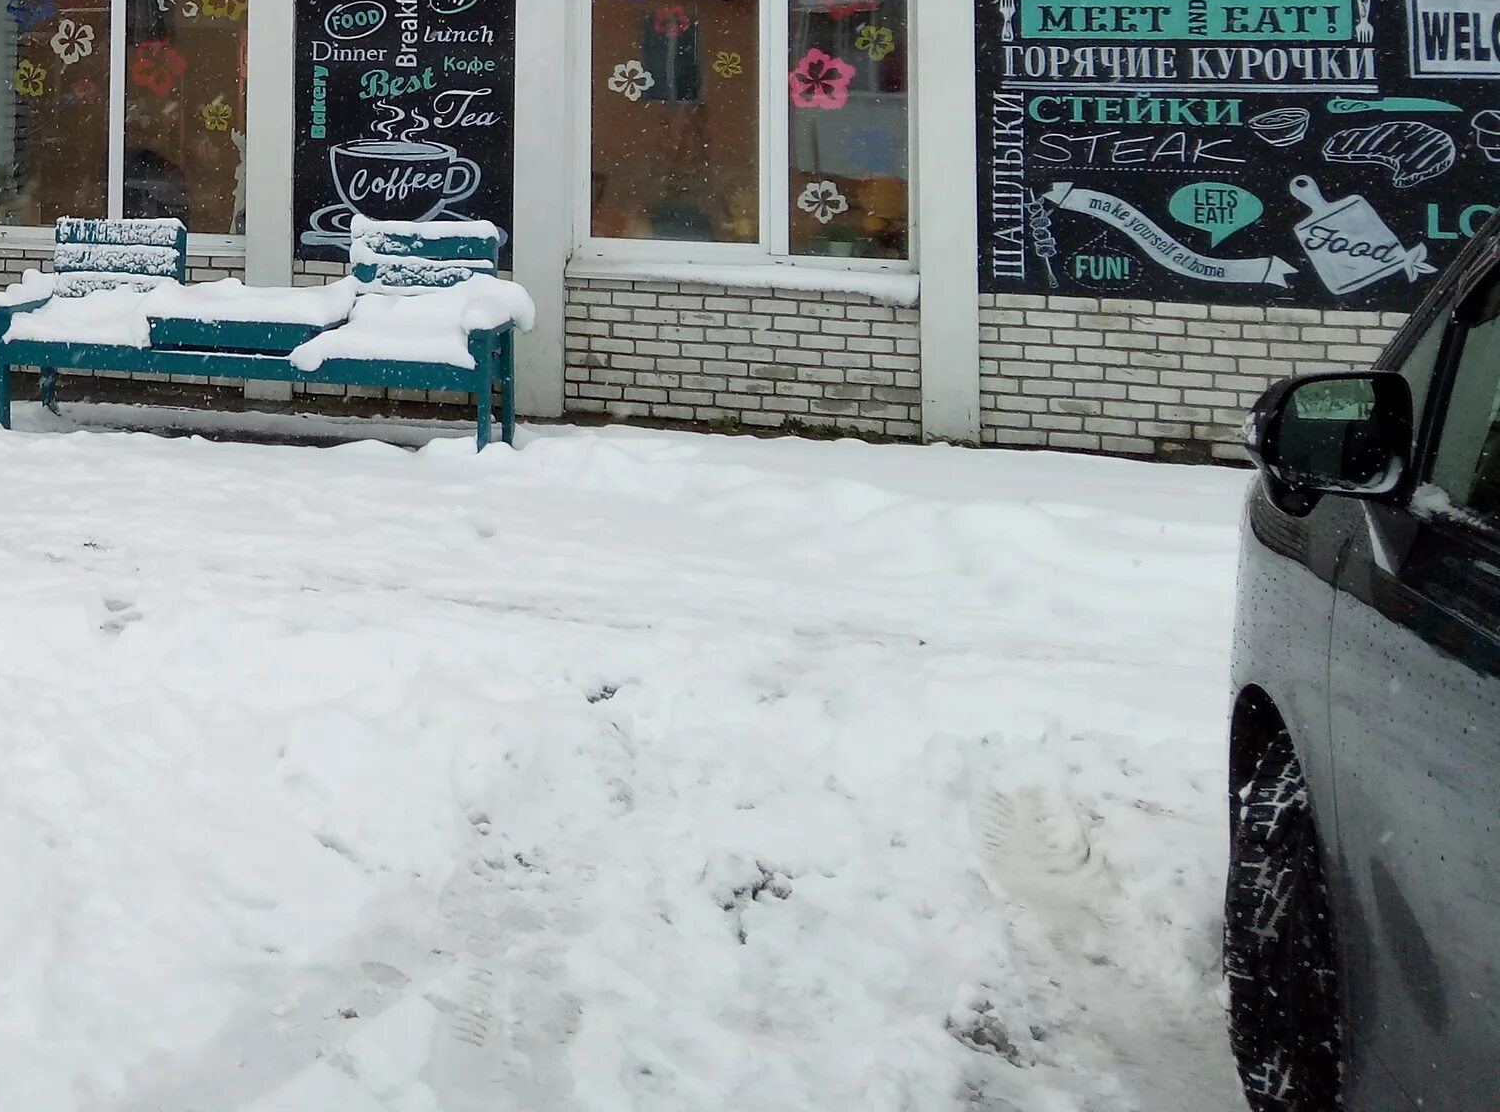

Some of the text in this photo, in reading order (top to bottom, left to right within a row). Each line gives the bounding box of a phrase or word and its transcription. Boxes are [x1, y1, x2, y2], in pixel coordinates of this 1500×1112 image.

[331, 9, 381, 31] FOOD
[423, 25, 494, 46] Lunch
[1037, 0, 1341, 37] MEET AND EAT!
[311, 40, 388, 63] Dinner
[443, 55, 496, 75] Кофе
[1002, 45, 1379, 81] ГОРЯЧИЕ КУРОЧКИ
[359, 66, 438, 101] Best
[310, 64, 331, 139] Bakery
[433, 87, 501, 129] Tea
[1028, 92, 1244, 126] СТЕЙКИ
[1033, 130, 1247, 164] STEAK
[349, 167, 443, 202] Coffee
[992, 90, 1026, 280] ШАШЛЫКИ
[1194, 189, 1238, 208] LETS
[1089, 197, 1131, 221] make
[1124, 217, 1179, 255] yourself
[1172, 252, 1191, 267] at
[1194, 207, 1234, 225] EAT!
[1304, 225, 1398, 264] Food
[1075, 255, 1130, 281] FUN!
